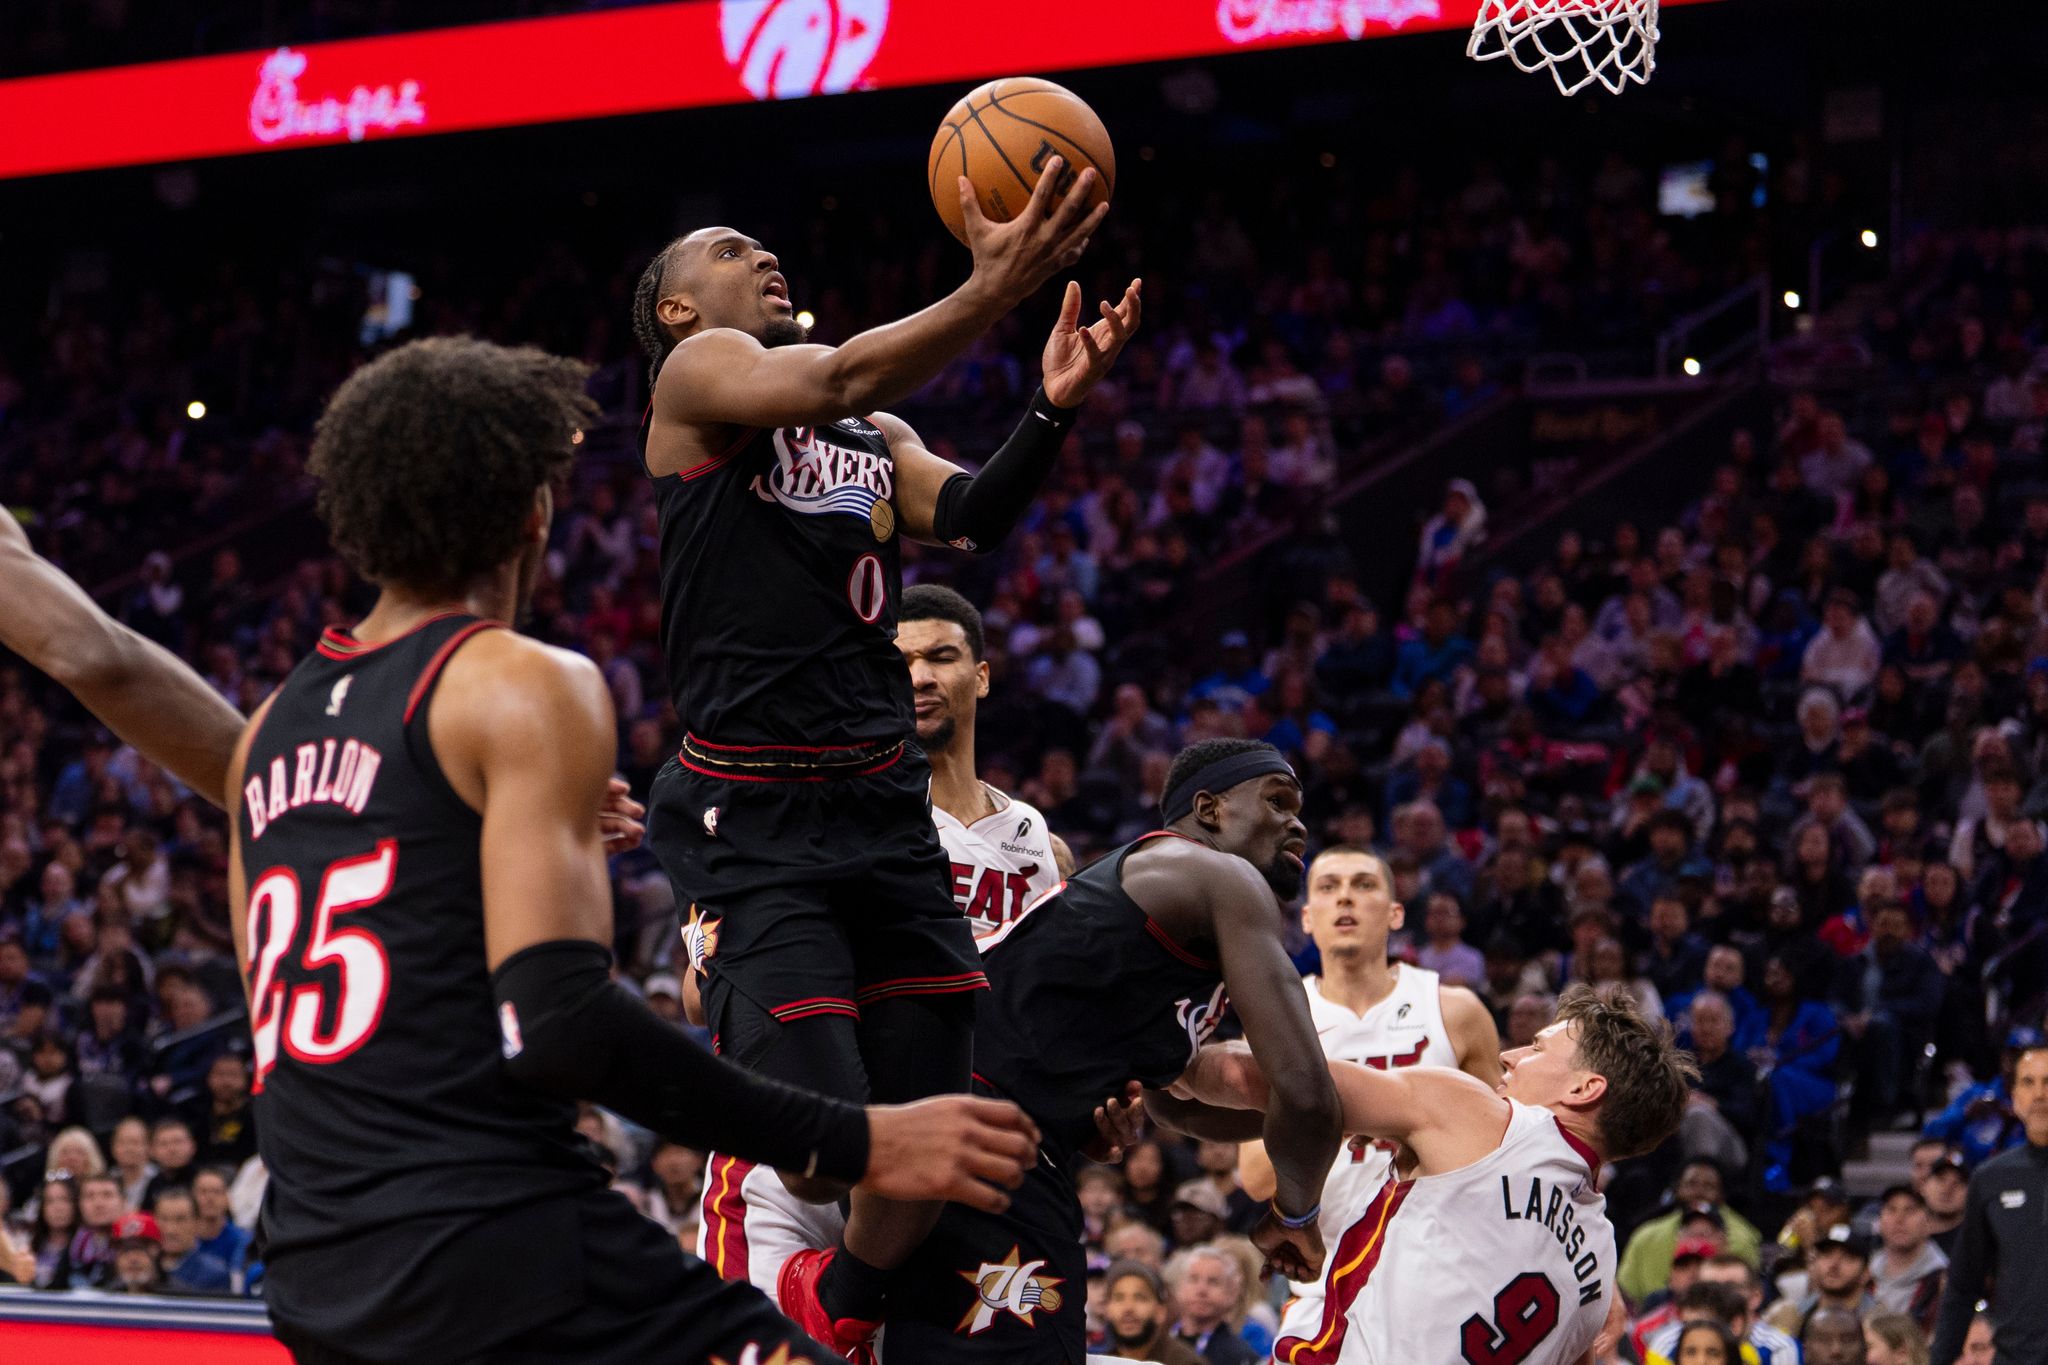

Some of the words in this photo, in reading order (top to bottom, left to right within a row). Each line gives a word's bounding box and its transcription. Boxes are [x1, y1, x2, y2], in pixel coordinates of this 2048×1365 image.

[847, 552, 887, 624] 0
[244, 737, 382, 841] BARLOW
[1000, 842, 1044, 858] Robinhood
[247, 837, 398, 1096] 25
[1501, 1175, 1602, 1307] LARSSON
[1460, 1272, 1561, 1365] 9
